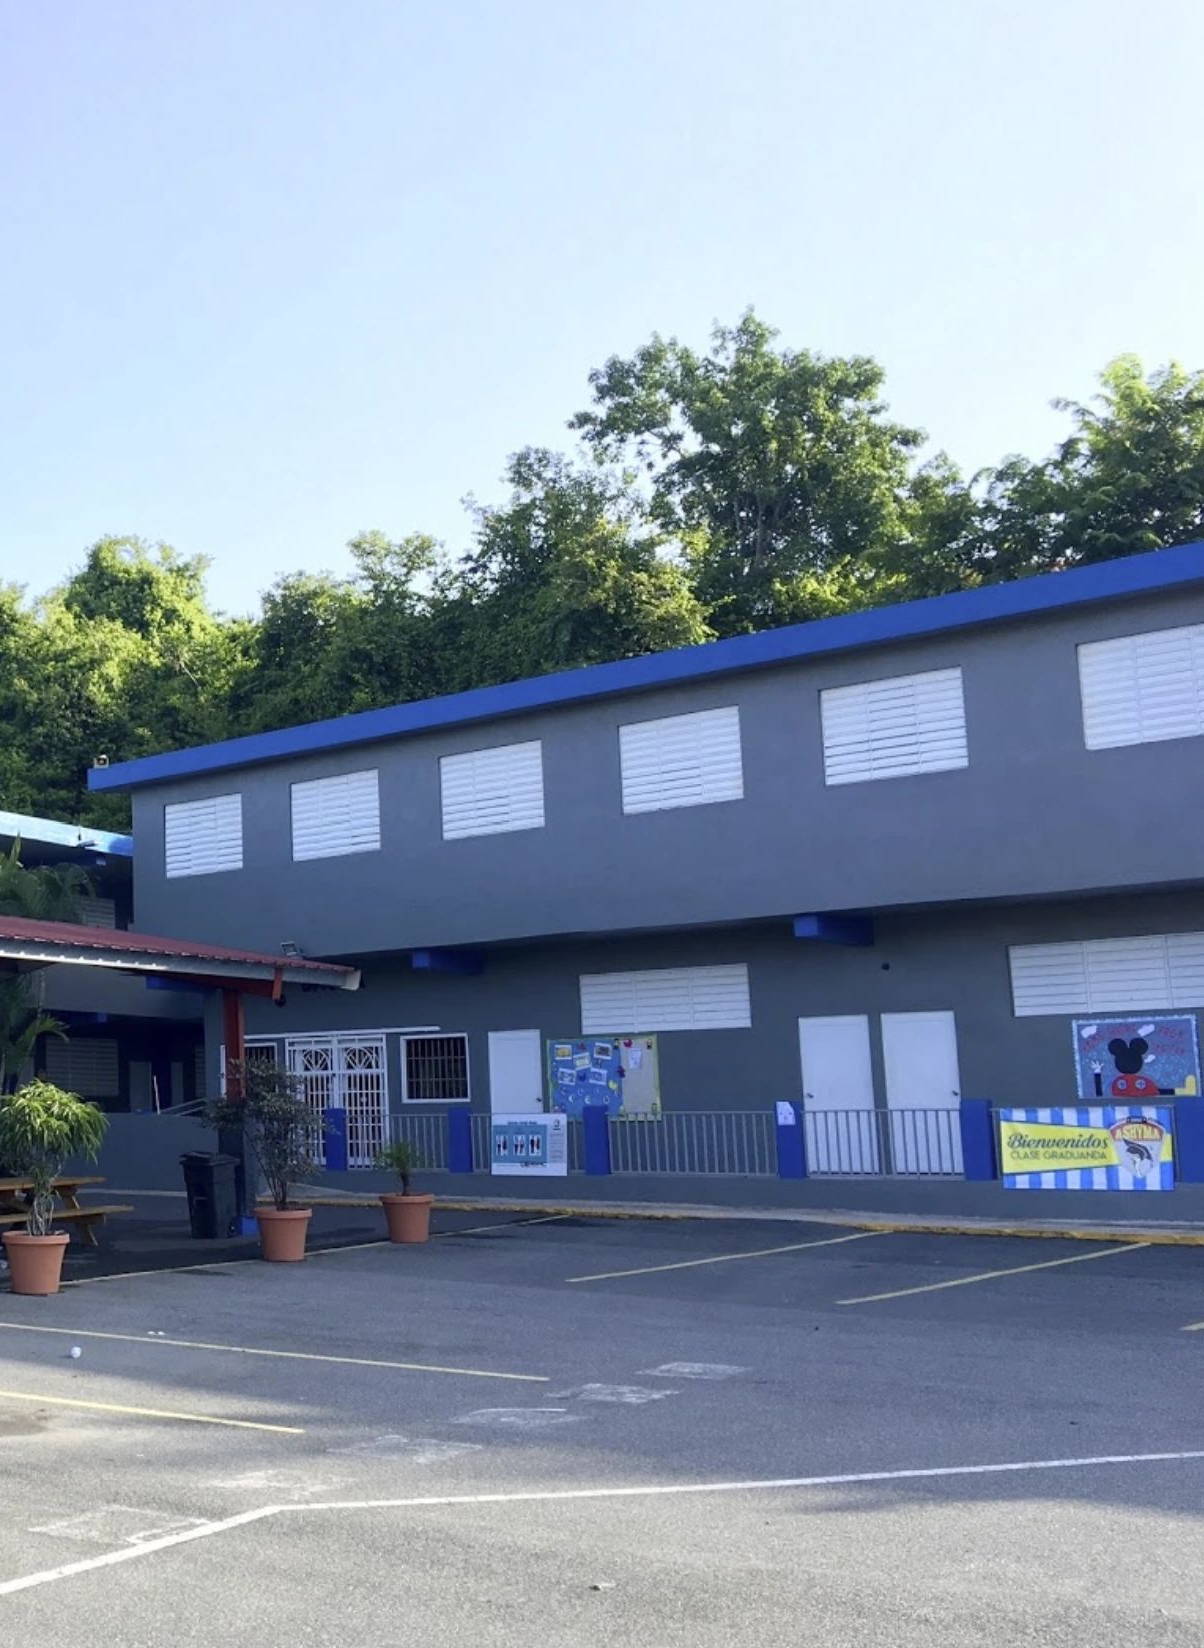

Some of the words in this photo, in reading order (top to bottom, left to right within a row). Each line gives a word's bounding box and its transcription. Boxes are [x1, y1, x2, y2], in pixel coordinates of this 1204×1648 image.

[1007, 1133, 1109, 1149] Bienvenidos
[1010, 1150, 1040, 1160] CLASE
[1043, 1150, 1107, 1160] GRADUANDA
